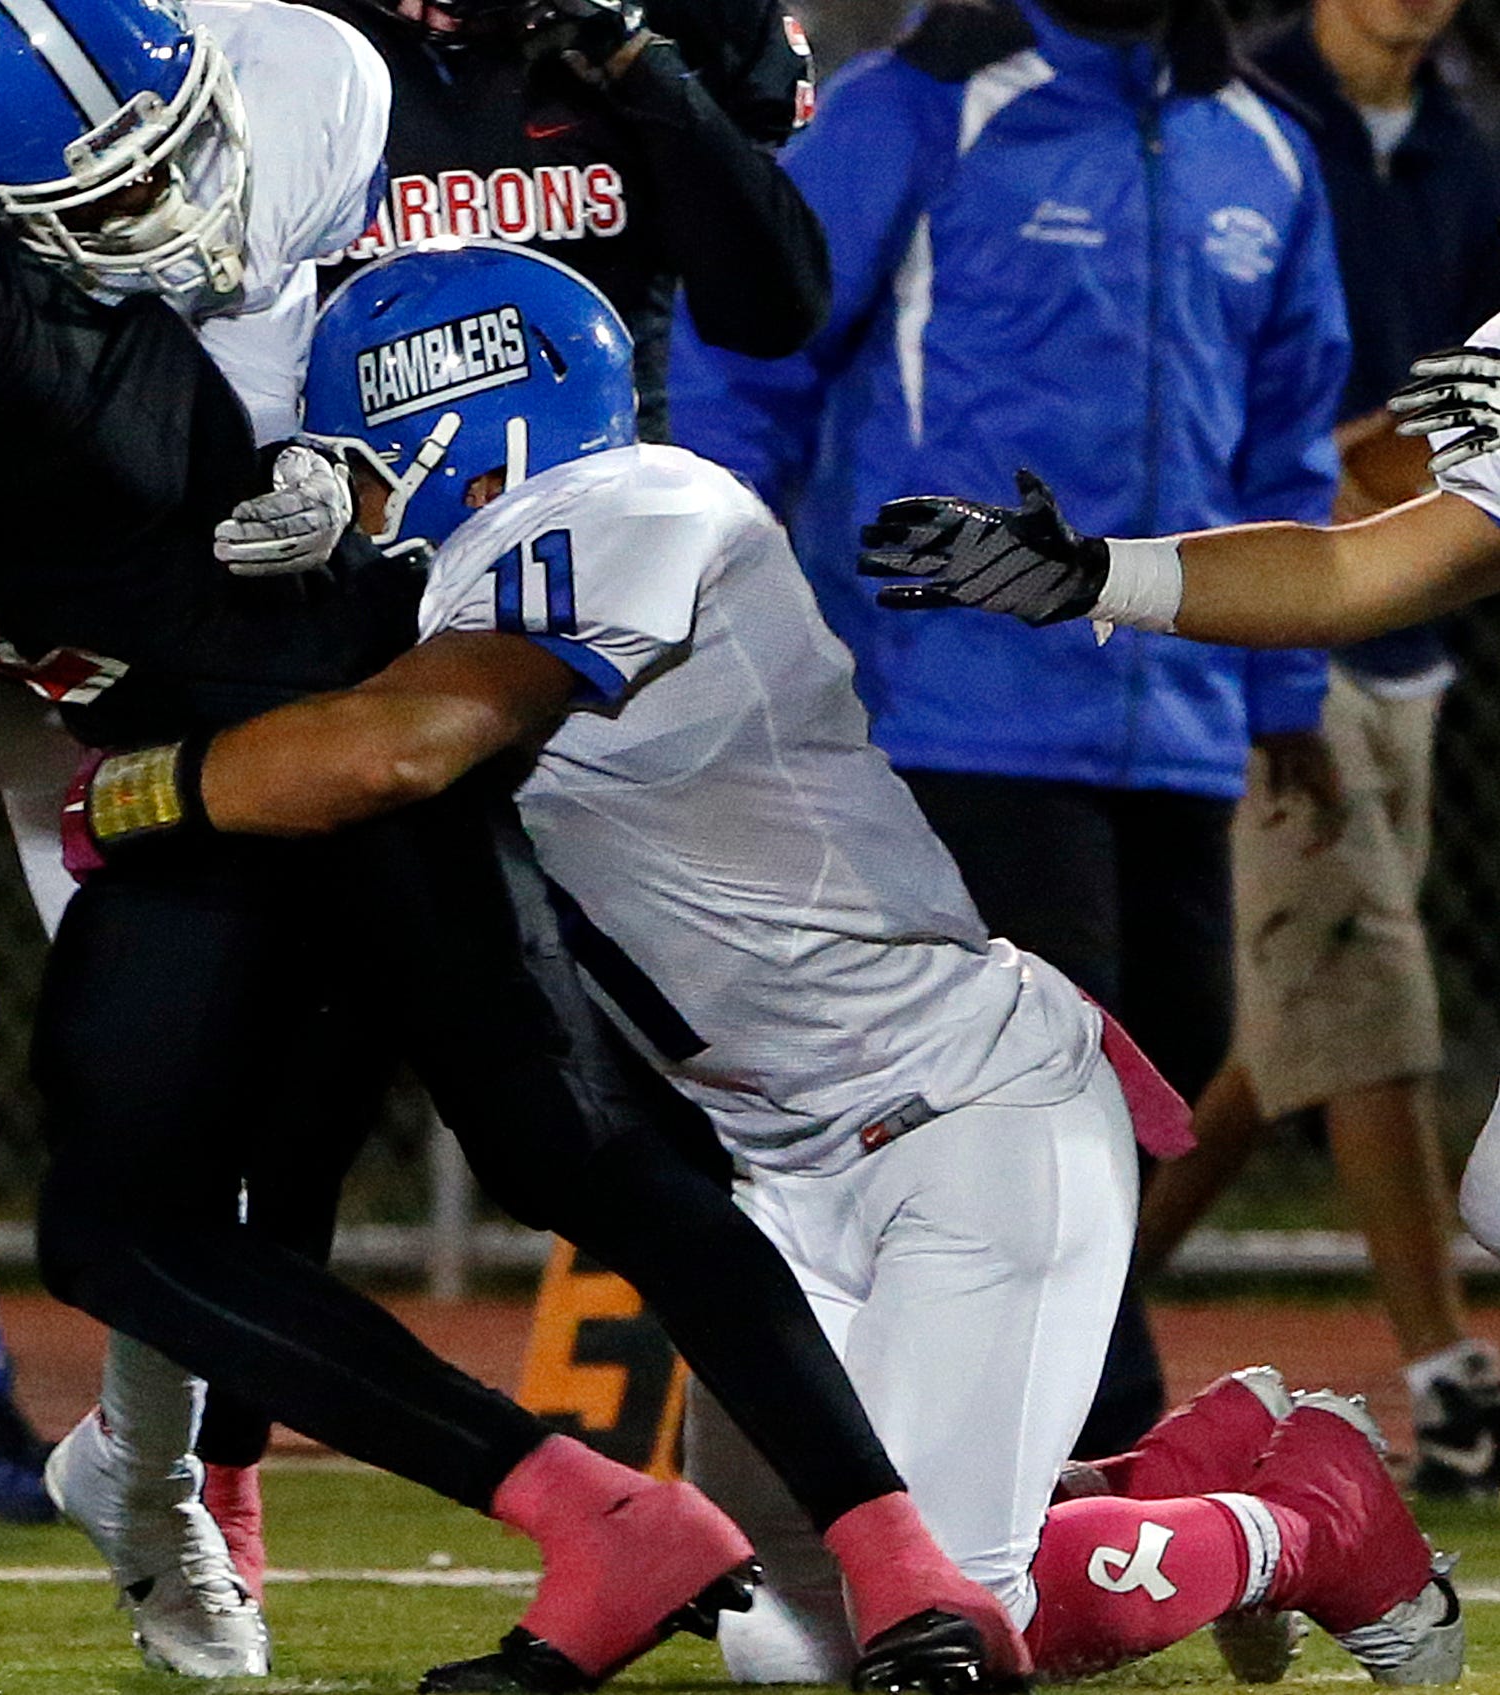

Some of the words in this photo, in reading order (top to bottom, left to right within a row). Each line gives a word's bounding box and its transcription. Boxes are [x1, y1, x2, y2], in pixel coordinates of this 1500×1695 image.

[330, 163, 628, 260] ARRONS
[357, 306, 526, 413] RAMBLERS
[486, 528, 577, 636] 11
